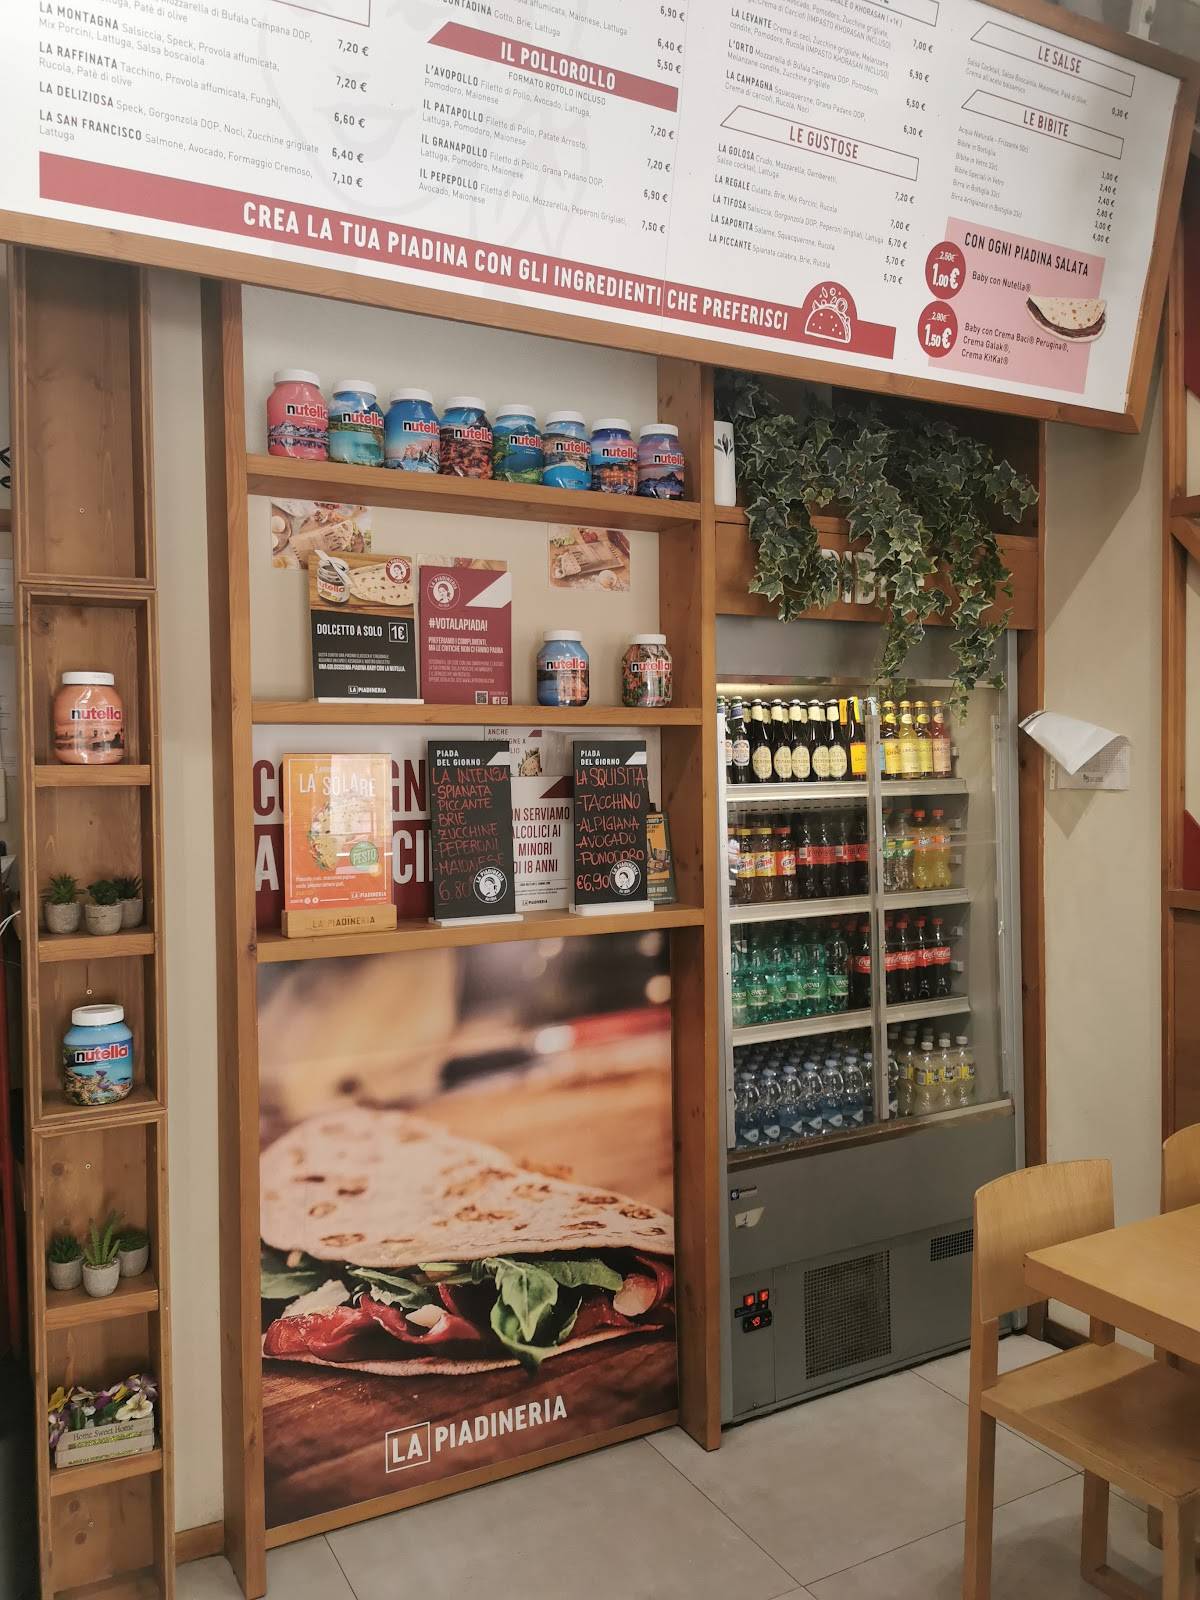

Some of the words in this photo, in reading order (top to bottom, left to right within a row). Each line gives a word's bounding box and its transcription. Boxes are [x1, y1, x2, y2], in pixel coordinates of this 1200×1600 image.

[660, 5, 676, 19] 6,90
[731, 7, 740, 18] LA
[741, 11, 772, 29] LEVANTE
[39, 0, 52, 14] LA
[57, 5, 118, 31] MONTAGNA
[122, 22, 164, 43] Salsiccia,
[167, 34, 196, 51] Speck,
[198, 42, 230, 60] Provola
[234, 51, 279, 72] affumicata,
[337, 39, 358, 55] 7,20
[657, 37, 673, 52] 6,40
[728, 38, 753, 54] L'ORTO
[39, 40, 52, 54] LA
[57, 45, 117, 70] RAFFINATA
[120, 62, 162, 82] Tacchino,
[165, 72, 198, 90] Provola
[500, 41, 515, 62] IL
[520, 46, 616, 91] POLLOROLLO
[1037, 45, 1050, 62] LE
[1051, 50, 1081, 73] SALSE
[336, 75, 356, 91] 7,20
[425, 63, 478, 87] L'AVOPOLLO
[726, 70, 734, 80] LA
[735, 73, 773, 91] CAMPAGNA
[39, 80, 52, 94] LA
[57, 84, 113, 107] DELIZIOSA
[508, 71, 543, 89] FORMATO
[544, 81, 573, 97] ROTOLO
[575, 90, 606, 106] INCLUSO
[334, 112, 354, 126] 6,60
[423, 99, 431, 110] IL
[434, 101, 483, 123] PATAPOLLO
[1023, 110, 1035, 126] LE
[1037, 114, 1068, 136] BIBITE
[39, 125, 74, 142] Lattuga
[650, 125, 666, 139] 7,20
[39, 109, 52, 122] LA
[57, 113, 78, 128] SAN
[82, 118, 141, 141] FRANCISCO
[145, 133, 185, 152] Salmone,
[188, 143, 225, 161] Avocado,
[228, 151, 272, 171] Formaggio
[274, 161, 312, 179] Cremoso,
[421, 133, 429, 144] IL
[432, 136, 487, 158] GRANAPOLLO
[789, 125, 803, 143] LE
[806, 130, 858, 159] GUSTOSE
[332, 147, 352, 161] 6,40
[718, 143, 726, 153] LA
[728, 146, 754, 160] GOLOSA
[646, 158, 662, 171] 7,20
[331, 172, 352, 186] 7,10
[420, 168, 427, 179] IL
[430, 170, 477, 190] PEPEPOLLO
[714, 174, 723, 184] LA
[724, 176, 750, 190] REGALE
[643, 188, 659, 202] 6,90
[712, 193, 721, 203] LA
[722, 196, 746, 209] TIFOSA
[640, 220, 657, 233] 7,50
[710, 213, 719, 223] LA
[720, 216, 753, 231] SAPORITA
[708, 233, 717, 242] LA
[718, 235, 751, 250] PICCANTE
[964, 232, 985, 250] CON
[987, 238, 1012, 257] OGNI
[1014, 245, 1053, 267] PIADINA
[1054, 255, 1089, 276] SALATA
[242, 200, 299, 235] CREA
[307, 213, 334, 241] LA
[339, 220, 381, 251] TUA
[387, 230, 468, 268] PIADINA
[473, 248, 512, 277] CON
[517, 257, 548, 284] GLI
[553, 265, 662, 307] INGREDIENTI
[666, 288, 698, 314] CHE
[701, 295, 788, 331] PREFERISCI
[971, 271, 988, 282] Baby
[989, 275, 1000, 285] con
[964, 322, 980, 333] Baby
[981, 326, 992, 336] con
[993, 328, 1014, 340] Crema
[962, 336, 984, 347] Crema
[961, 349, 982, 360] Crema
[342, 412, 384, 428] nutella
[455, 427, 493, 442] nutella
[317, 624, 355, 636] DOLCETTO
[357, 625, 362, 636] A
[364, 626, 382, 637] SOLO
[391, 625, 405, 640] 1€
[429, 618, 487, 631] #VOTALAPIADA!
[546, 656, 586, 670] nutella
[632, 659, 672, 672] nutella
[71, 706, 121, 720] nutella
[432, 768, 450, 784] LA
[576, 769, 587, 785] LA
[590, 767, 646, 788] SQUISITA
[300, 774, 316, 793] LA
[323, 774, 376, 797] SOLARE
[438, 798, 492, 811] PICCANTE
[438, 812, 467, 826] BRIE
[524, 807, 570, 821] SERVIAMO
[552, 825, 560, 837] AI
[519, 842, 552, 856] MINORI
[525, 860, 533, 874] 18
[536, 860, 558, 872] ANNI
[76, 1045, 128, 1062] nutella
[73, 1431, 93, 1441] Home
[93, 1427, 113, 1437] Sweet
[114, 1424, 134, 1434] Home
[392, 1433, 423, 1464] LA
[435, 1395, 567, 1452] PIADINERIA
